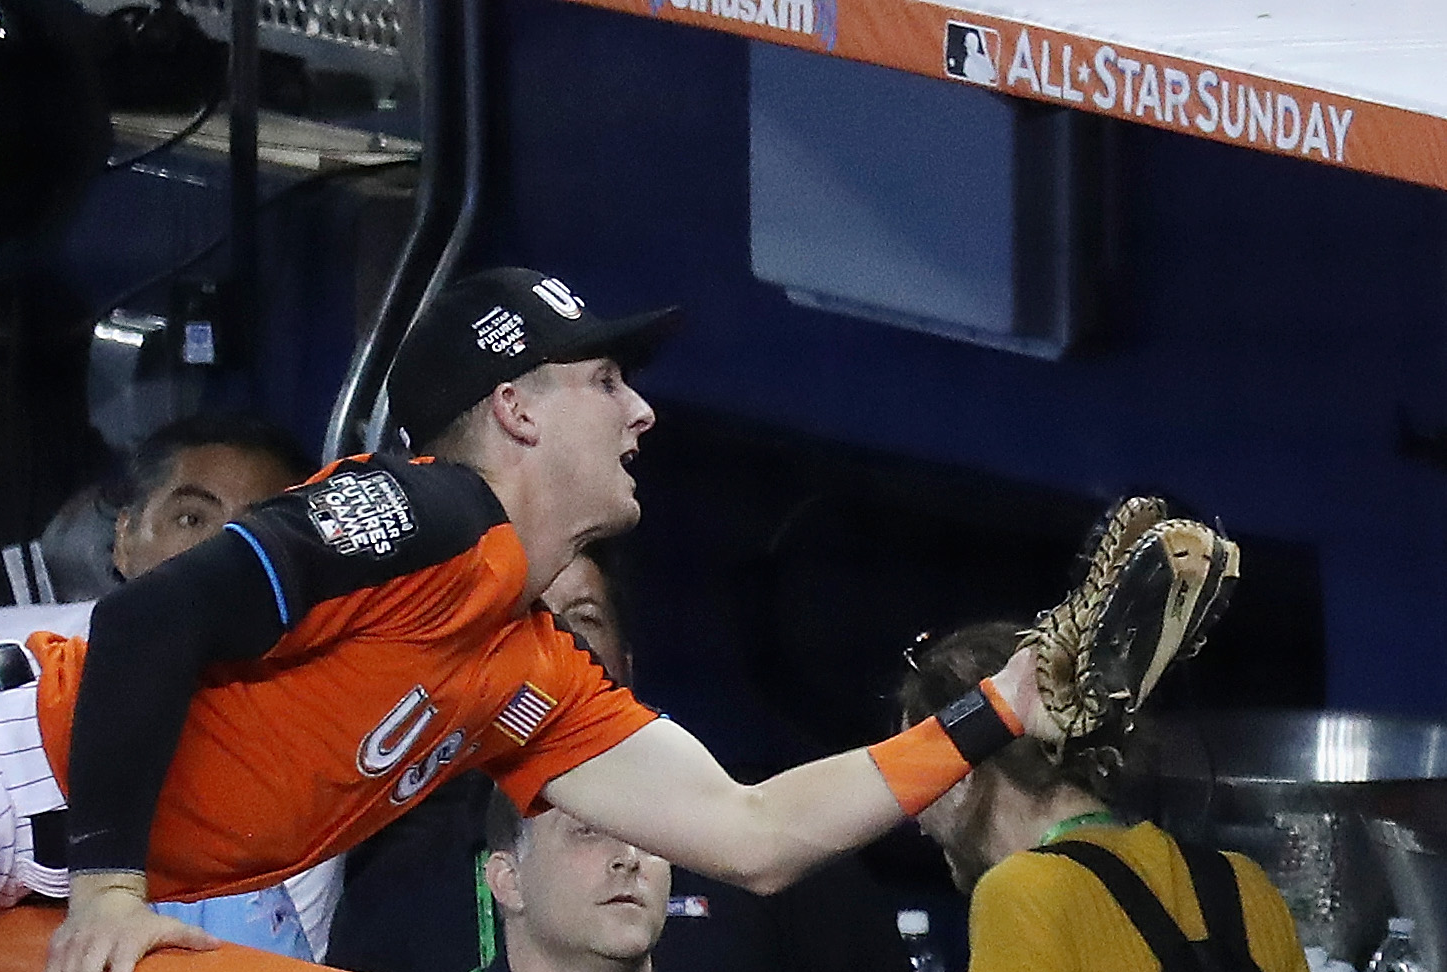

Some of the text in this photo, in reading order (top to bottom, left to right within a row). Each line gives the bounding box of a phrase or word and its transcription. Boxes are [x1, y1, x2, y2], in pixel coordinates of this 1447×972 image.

[1006, 28, 1353, 163] ALL STAR SUNDAY
[476, 313, 524, 350] FUTURES
[491, 327, 525, 352] GAME
[325, 491, 370, 550] GAME
[333, 475, 392, 554] FUTURES
[357, 479, 379, 502] ALL
[375, 503, 401, 539] STAR
